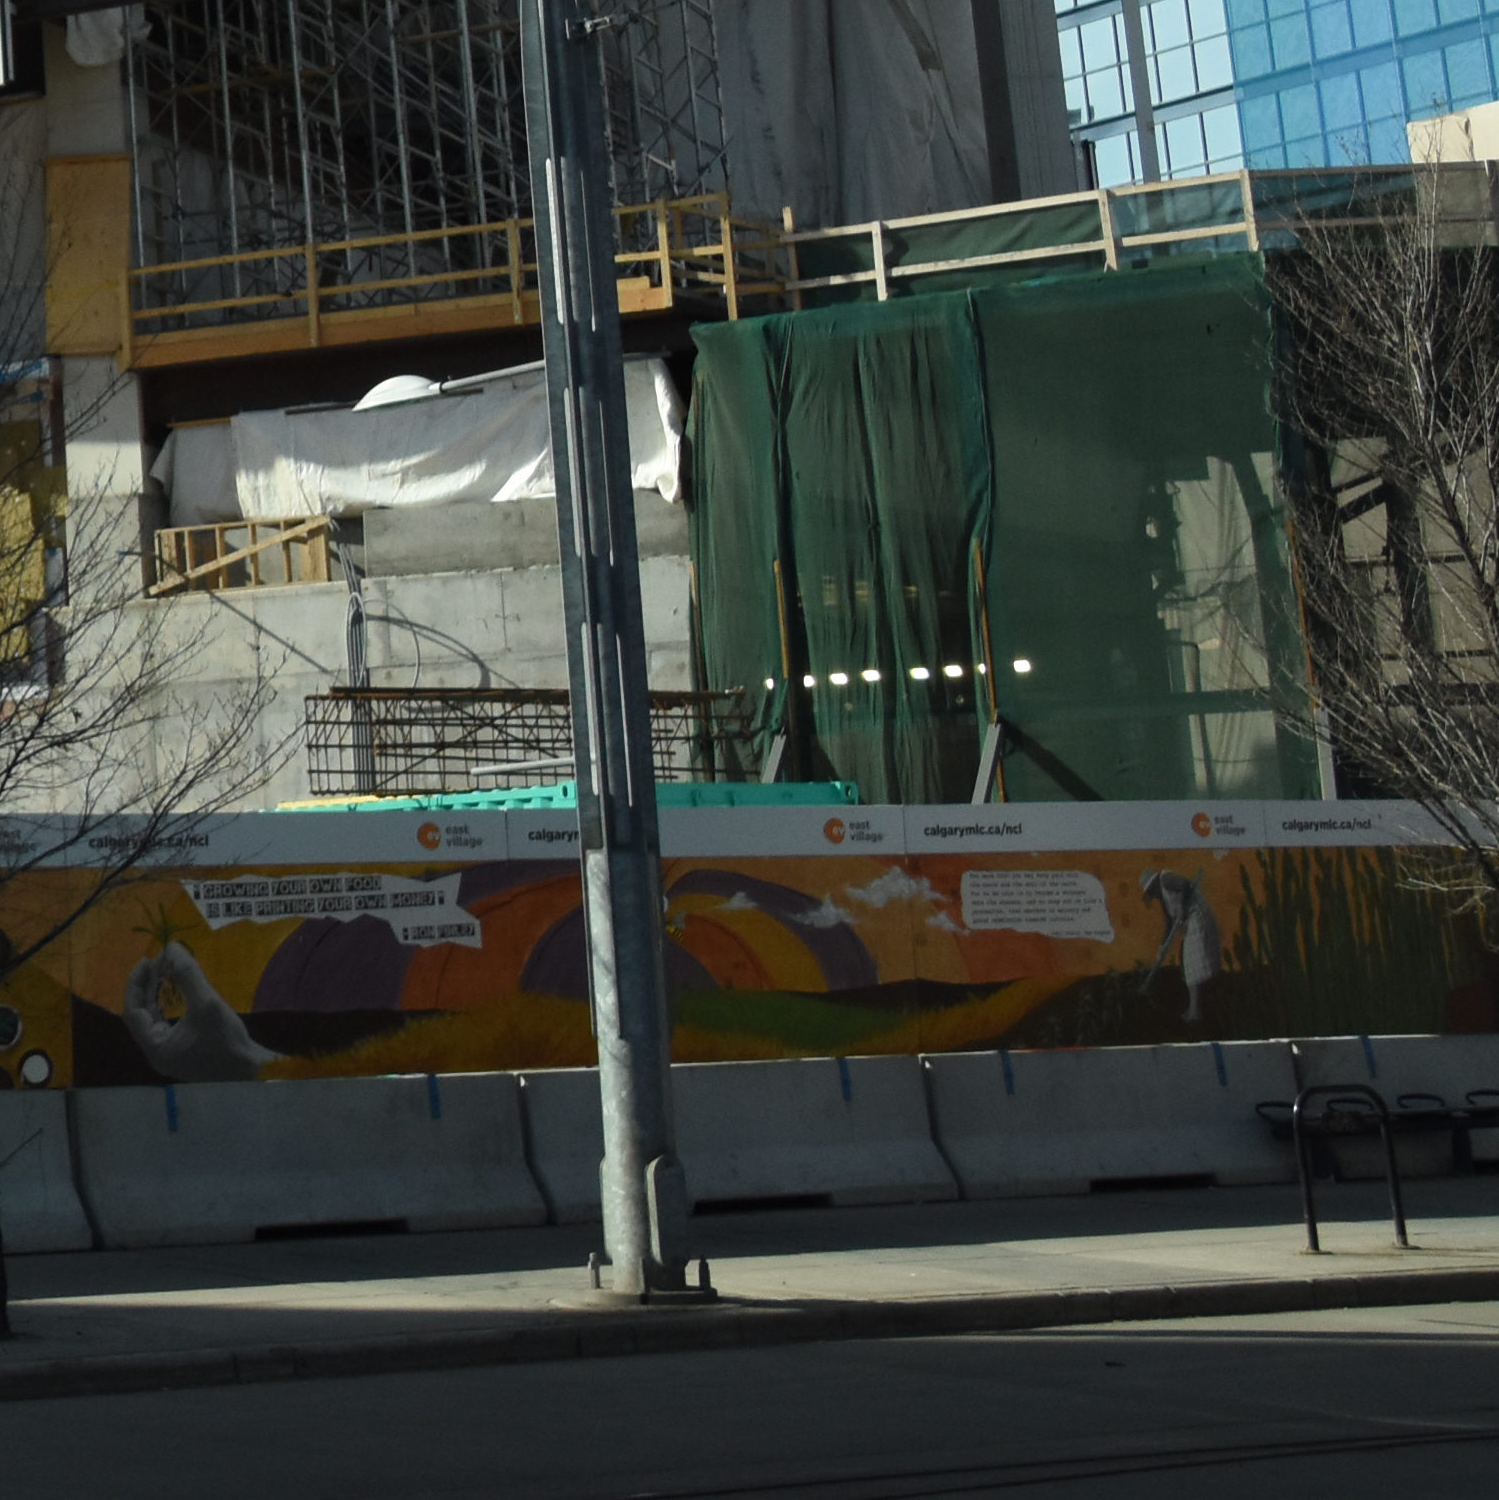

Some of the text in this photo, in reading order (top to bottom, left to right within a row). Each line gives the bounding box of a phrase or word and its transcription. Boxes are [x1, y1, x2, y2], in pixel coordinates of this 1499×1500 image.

[849, 820, 870, 830] east
[1214, 814, 1233, 825] east
[445, 823, 469, 835] east
[924, 822, 1023, 838] calgarymlc.ca/ncl
[1216, 824, 1246, 837] village
[446, 835, 483, 848] village
[850, 830, 883, 842] village
[308, 878, 343, 894] OWN
[345, 875, 381, 891] FOOD
[206, 902, 220, 918] IS
[222, 900, 252, 917] LIKE
[254, 898, 316, 916] PRINTING
[355, 893, 387, 910] OWN
